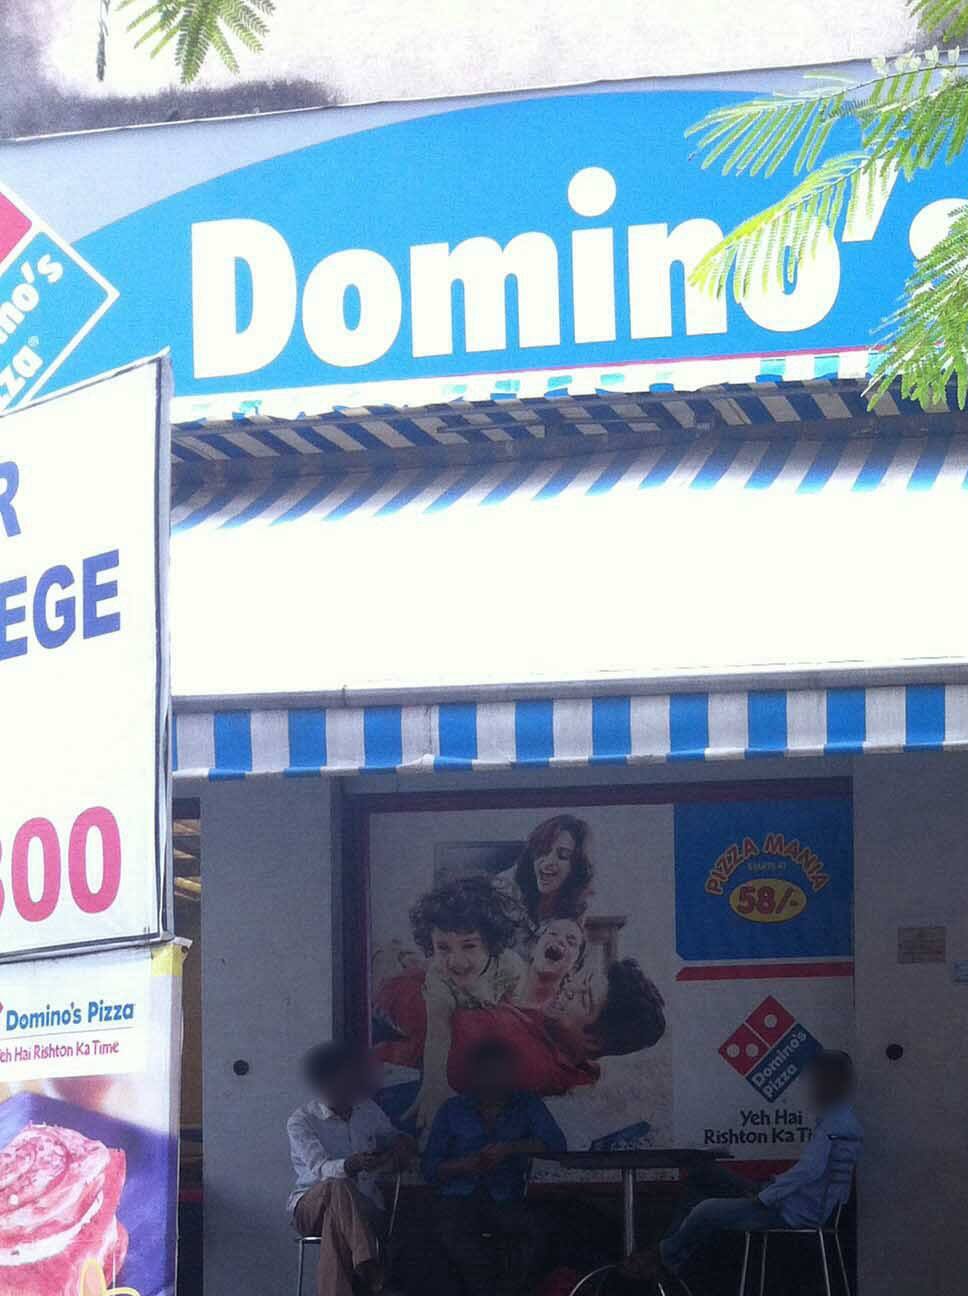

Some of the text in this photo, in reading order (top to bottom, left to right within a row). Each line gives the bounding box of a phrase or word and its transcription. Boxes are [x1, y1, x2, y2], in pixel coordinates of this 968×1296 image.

[0, 254, 63, 345] no's
[0, 806, 122, 922] 00
[705, 832, 831, 896] PIZZA MANIA
[7, 999, 135, 1031] Domino's Pizza
[15, 1047, 31, 1062] Hai
[34, 1043, 74, 1060] Rishton
[76, 1041, 91, 1057] Ka
[92, 1039, 119, 1056] Time
[751, 1030, 807, 1088] Domino's
[762, 1064, 798, 1098] Pizza
[740, 1109, 803, 1127] Yeh Hai
[704, 1128, 813, 1145] Rishton Ka Ti
